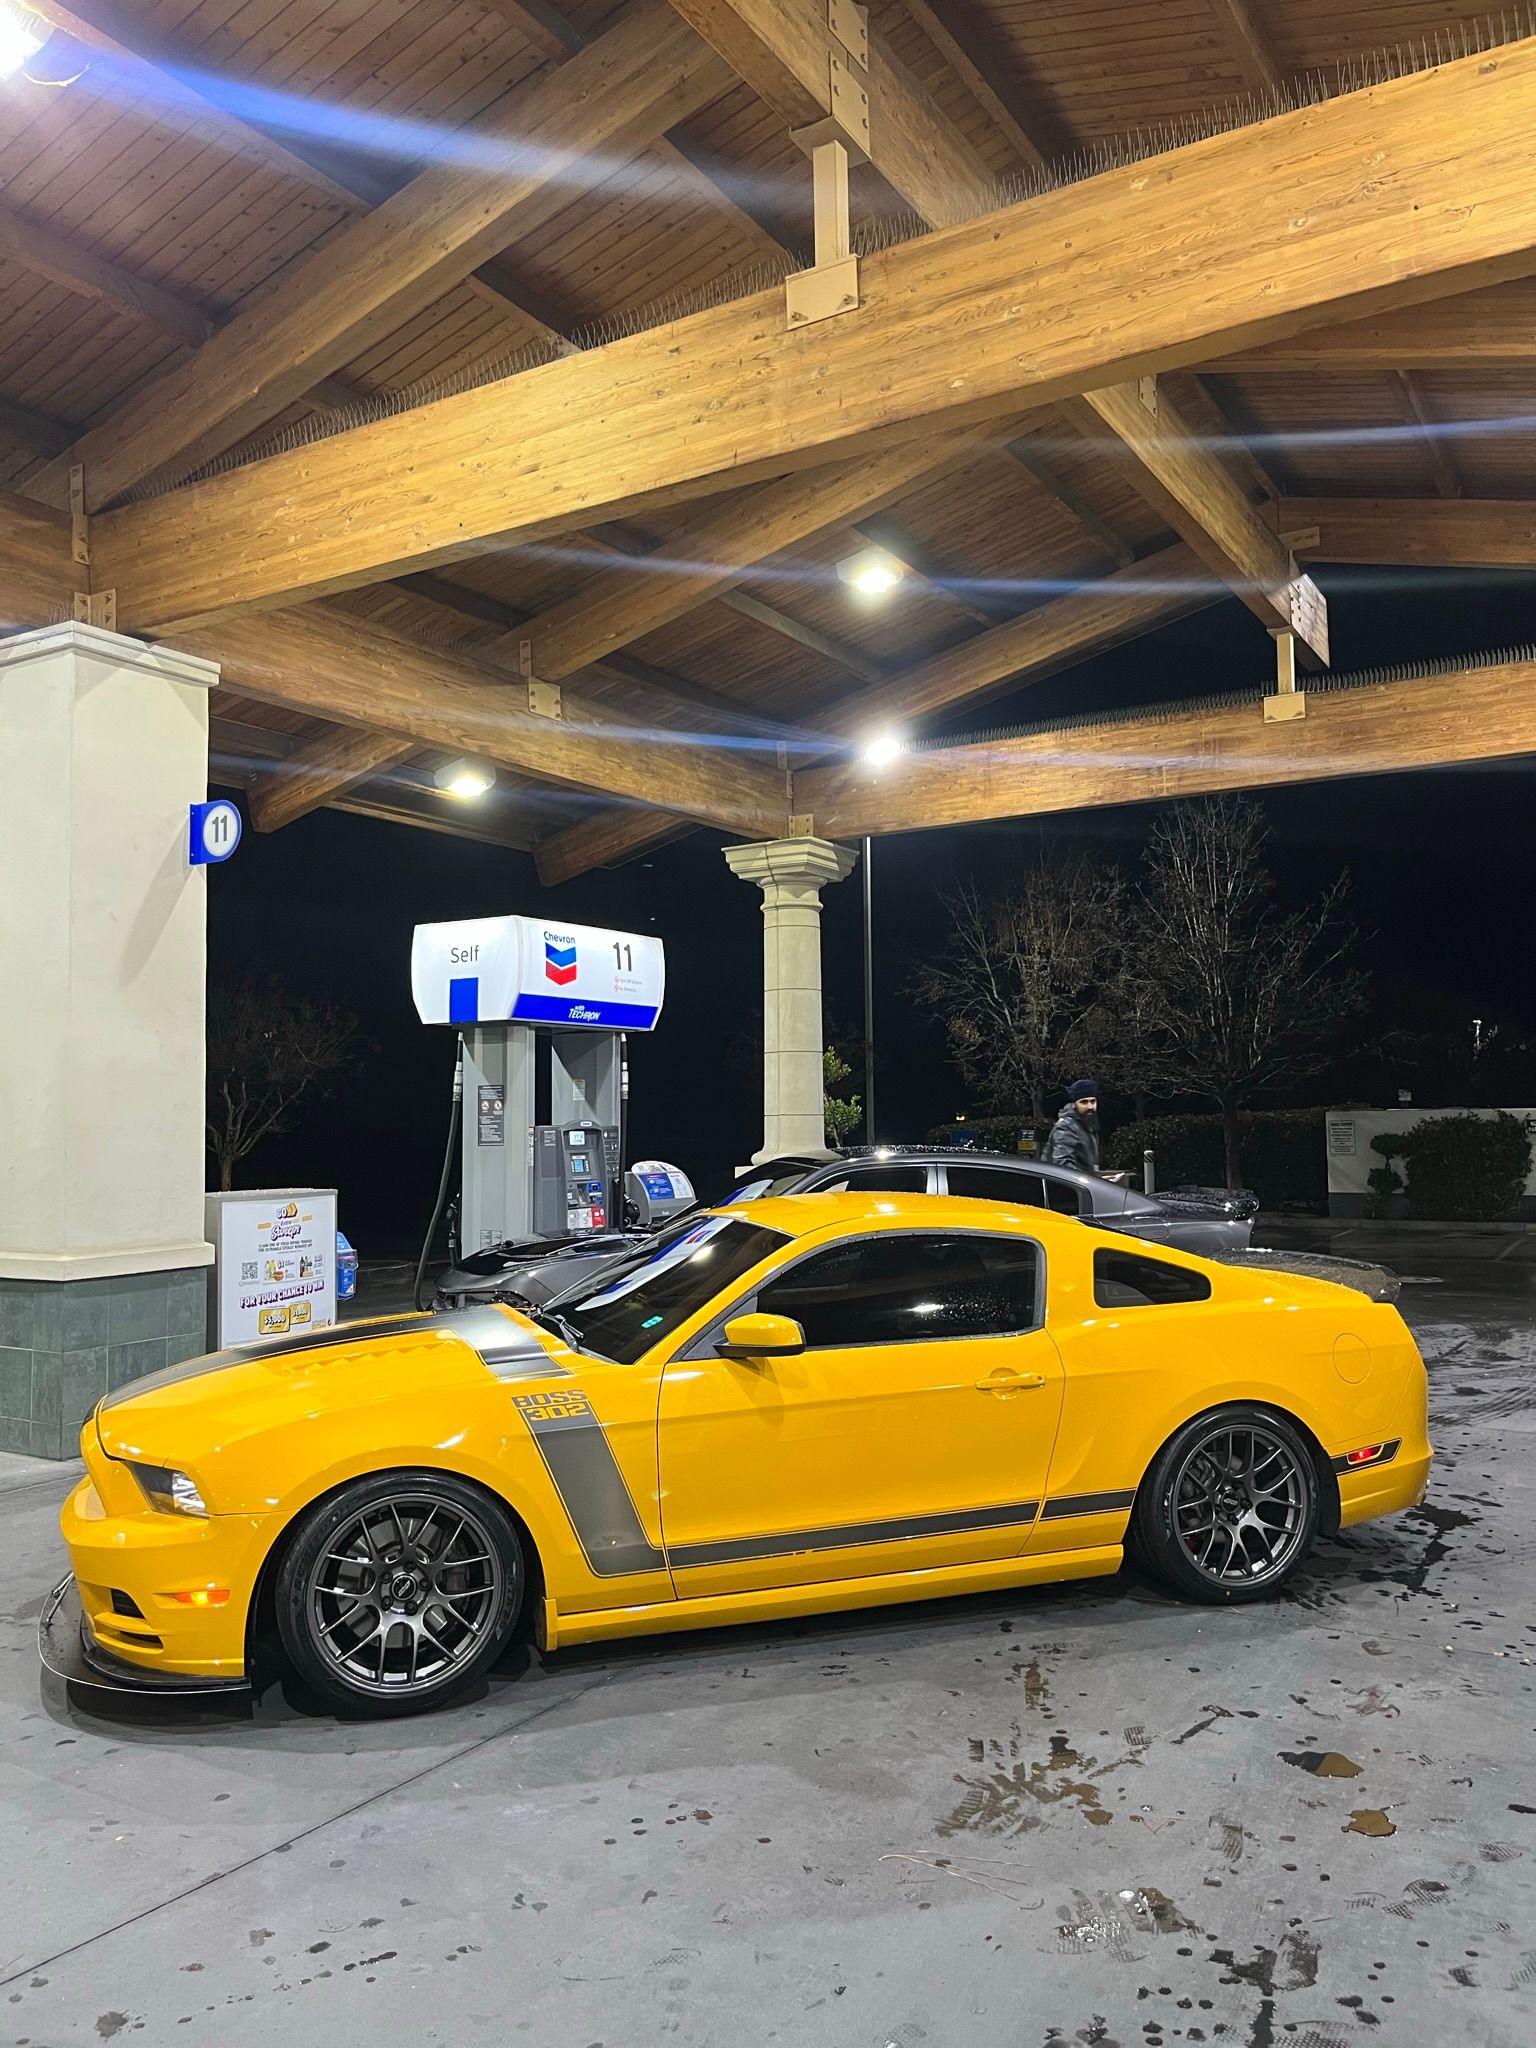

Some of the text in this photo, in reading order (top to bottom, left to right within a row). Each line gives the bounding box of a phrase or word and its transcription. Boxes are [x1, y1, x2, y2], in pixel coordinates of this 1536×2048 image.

[211, 815, 228, 843] 11
[543, 930, 576, 944] Chevron
[450, 944, 480, 963] Self
[612, 942, 632, 972] 11
[568, 1008, 601, 1021] TECHRON
[240, 1297, 257, 1309] FOR
[257, 1291, 278, 1305] YOUR
[278, 1285, 304, 1300] CHANCE
[512, 1389, 587, 1408] BOSS
[526, 1403, 589, 1421] 302
